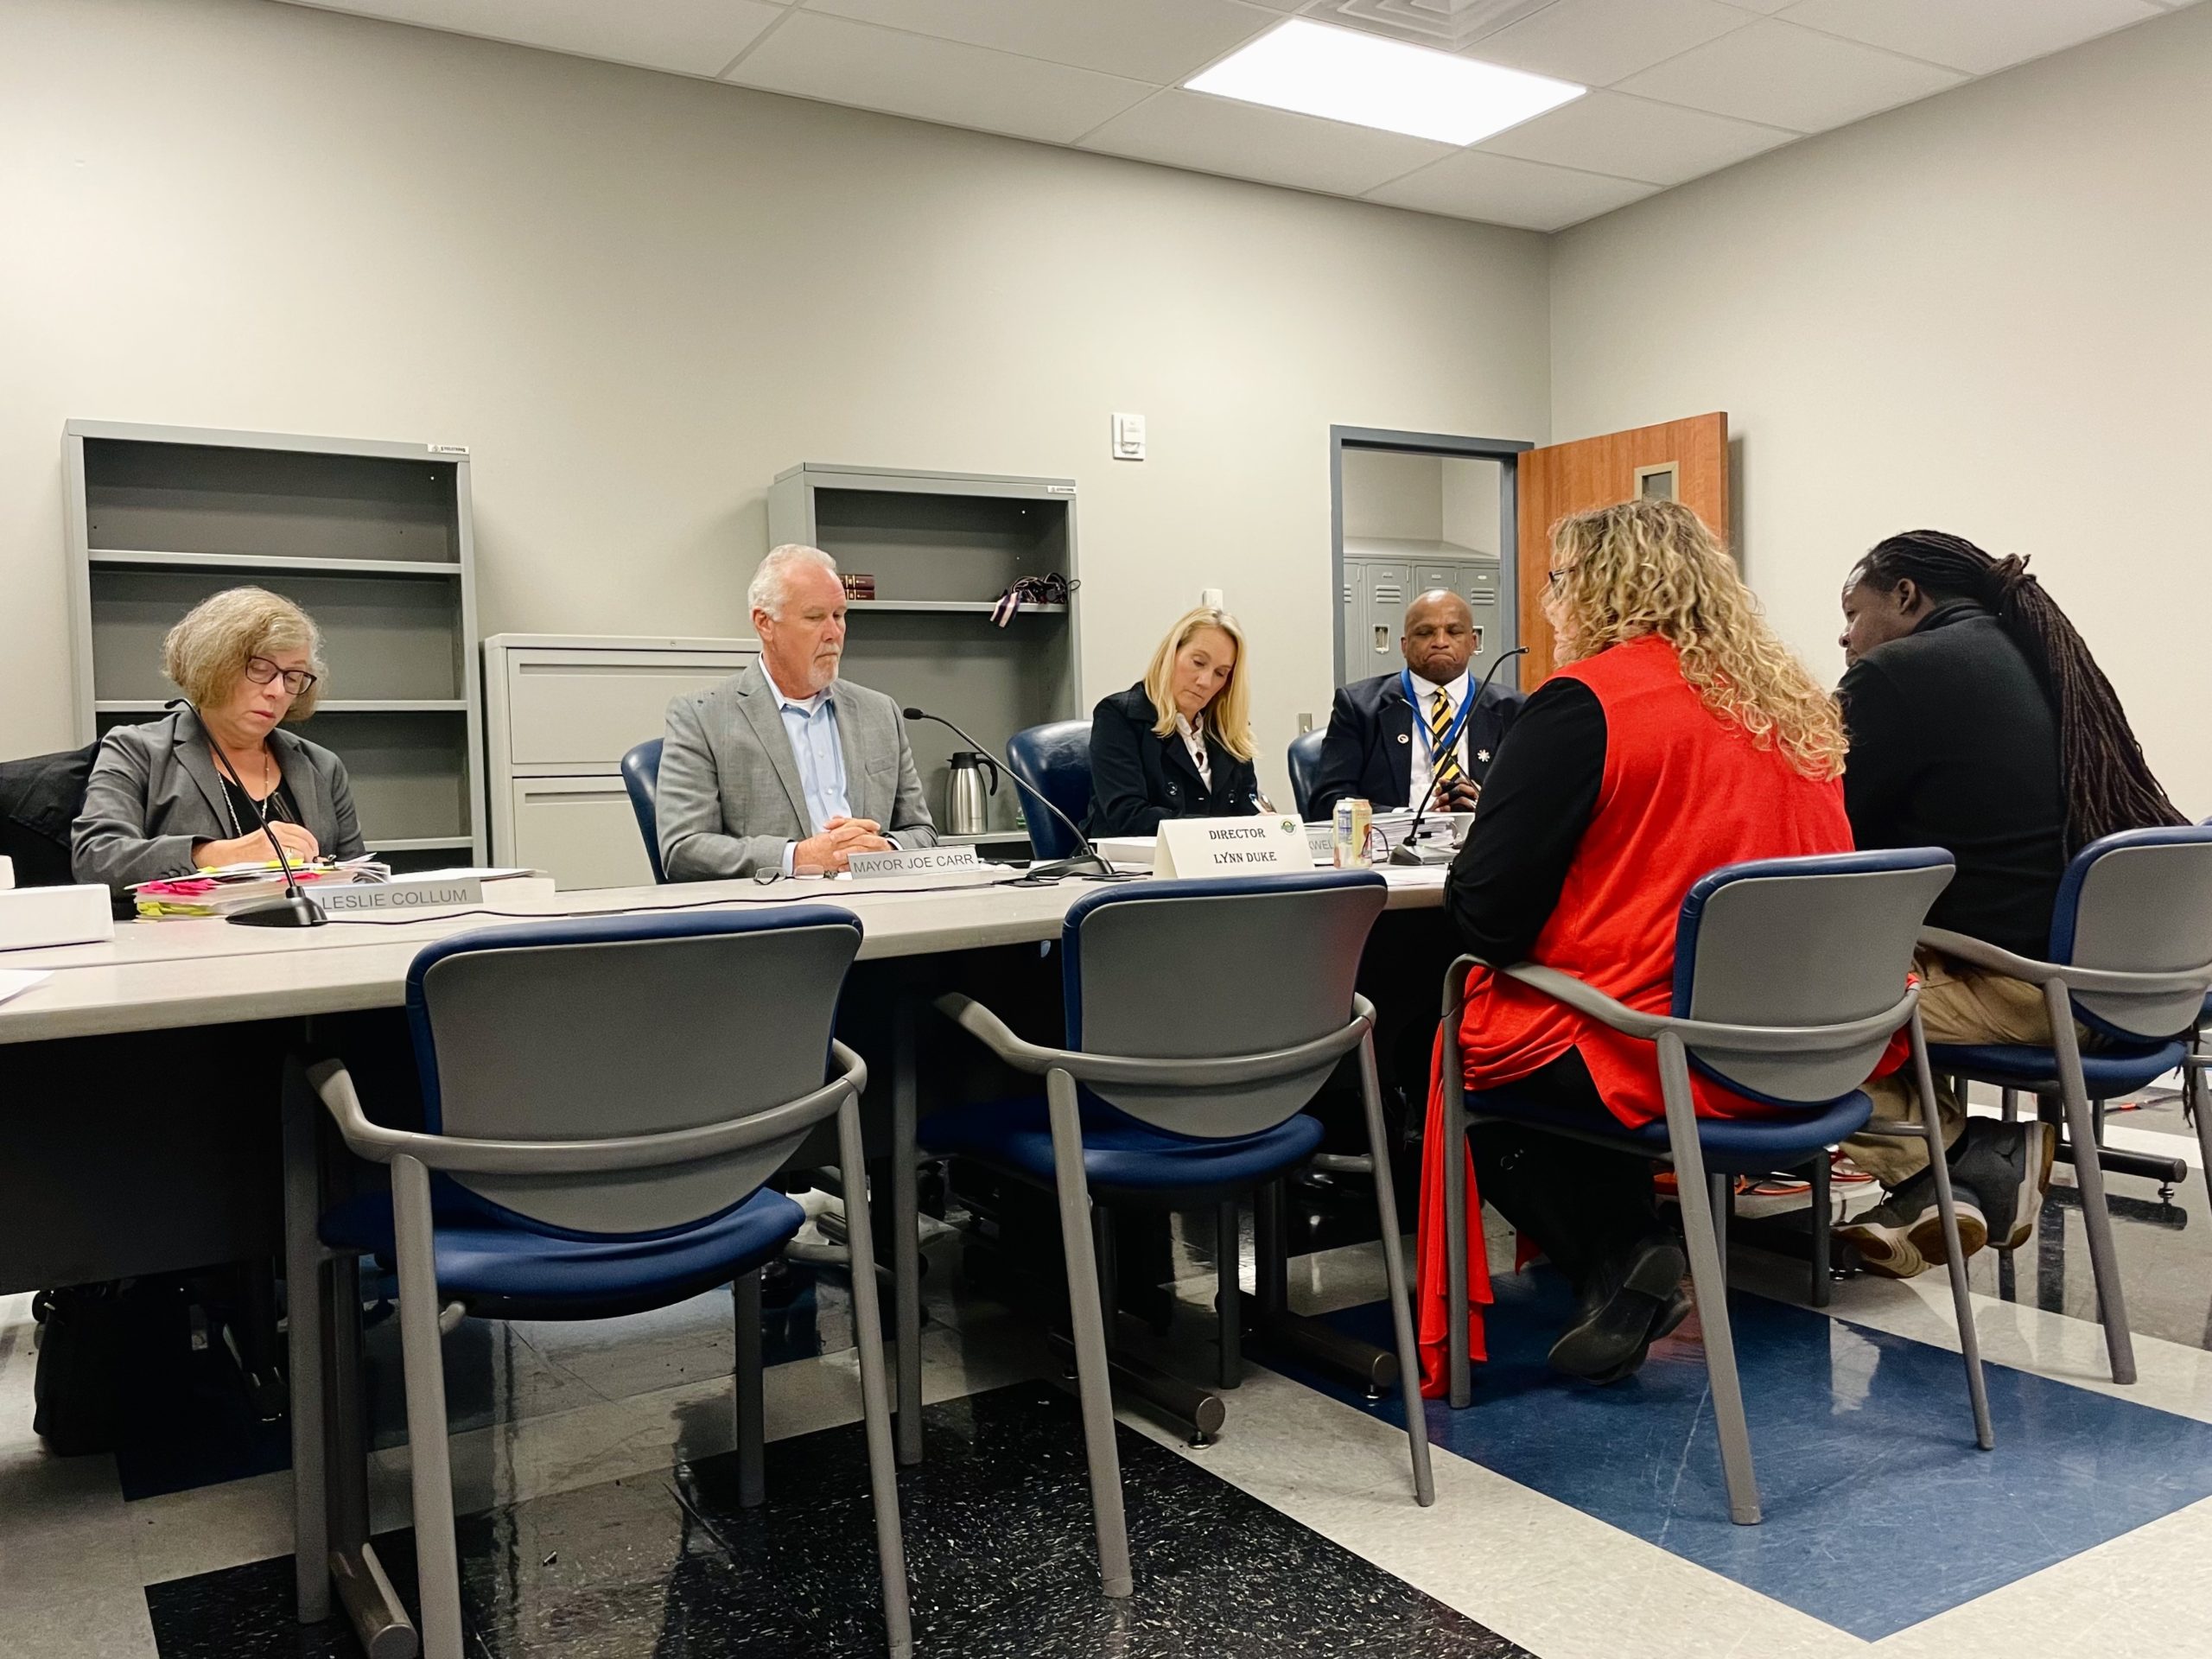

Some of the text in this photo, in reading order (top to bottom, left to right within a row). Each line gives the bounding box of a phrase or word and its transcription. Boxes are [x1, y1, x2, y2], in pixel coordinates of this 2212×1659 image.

[1209, 828, 1266, 840] DIRECTOR
[854, 854, 975, 874] MAYOR JOE CARR
[1214, 851, 1277, 864] LYNN DUKE
[321, 889, 467, 910] LESLIE COLLUM
